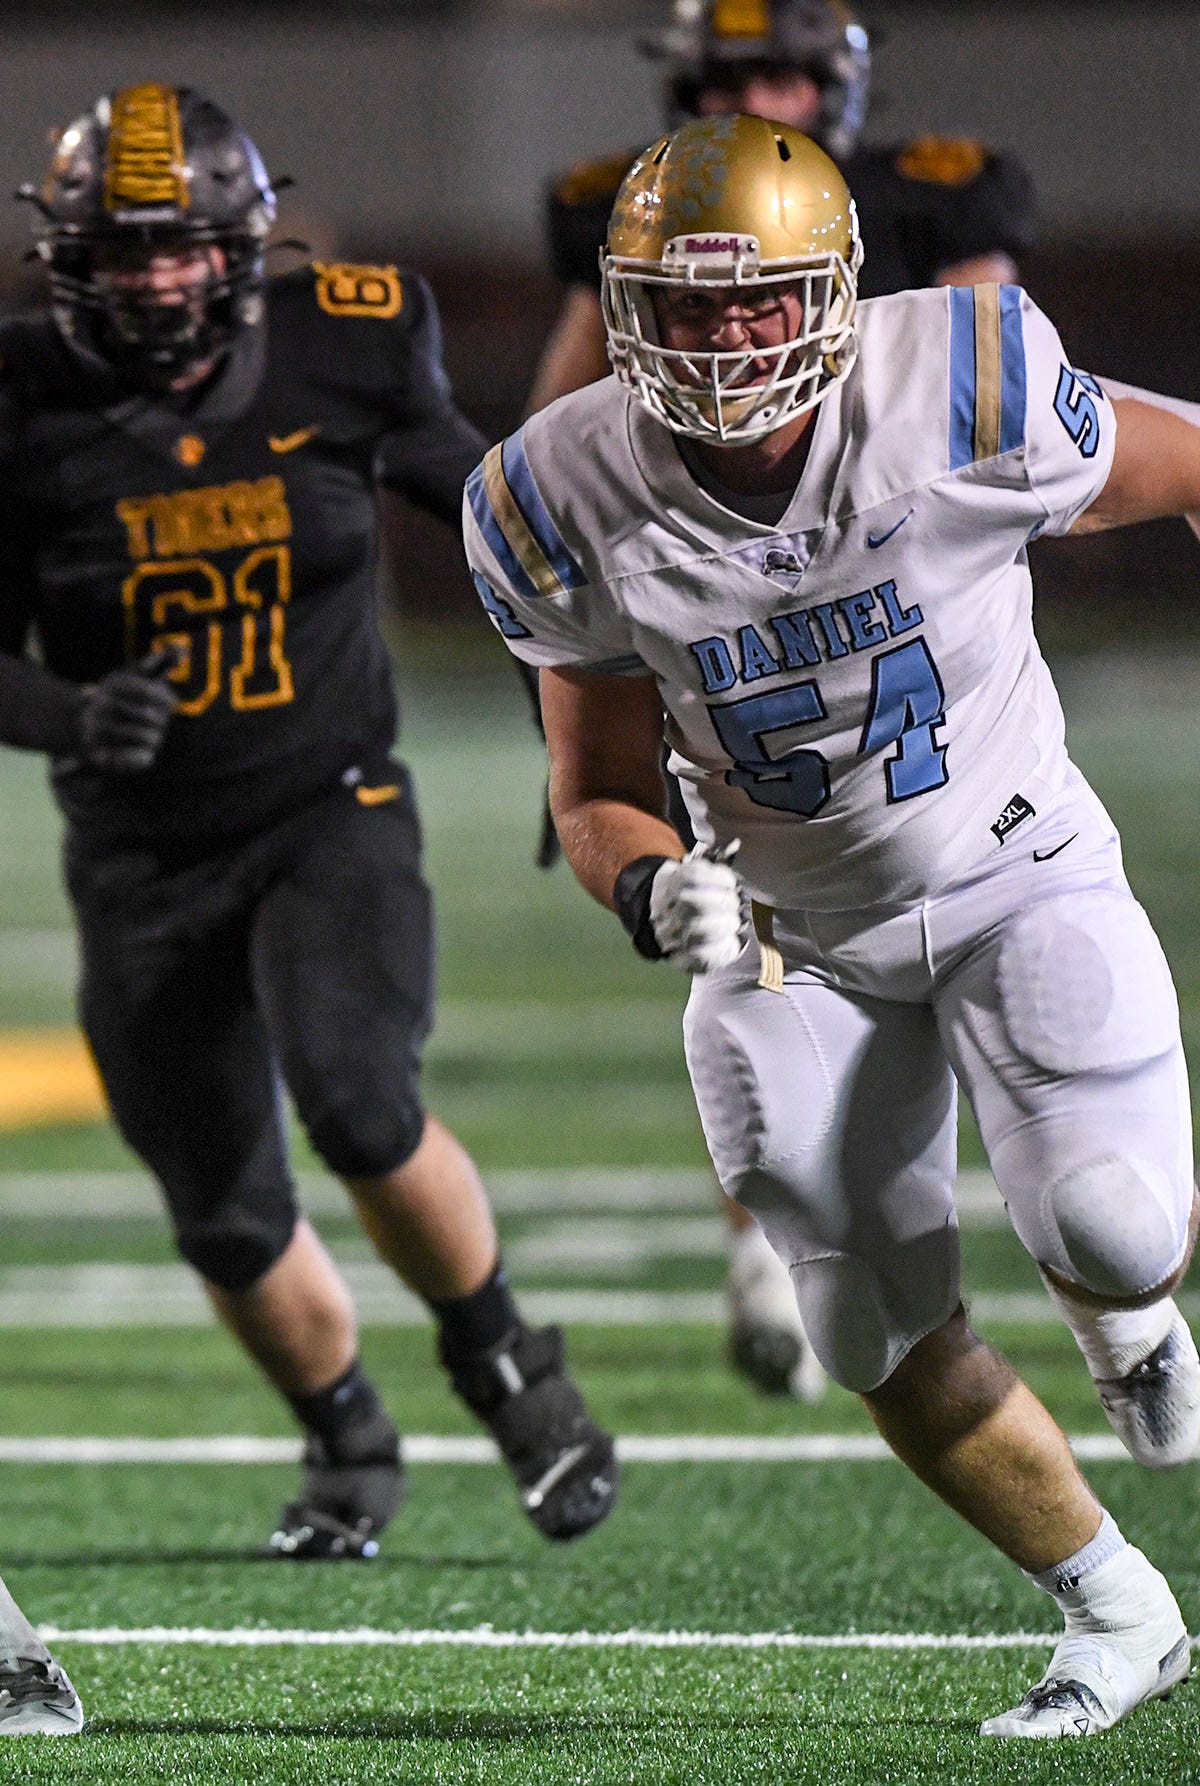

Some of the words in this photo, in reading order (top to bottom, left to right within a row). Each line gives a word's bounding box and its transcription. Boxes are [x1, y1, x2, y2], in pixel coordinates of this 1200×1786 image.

[685, 237, 741, 254] Riddell
[120, 545, 295, 716] 61
[689, 579, 924, 695] DANIEL
[705, 635, 950, 817] 54
[997, 804, 1027, 831] 2XL
